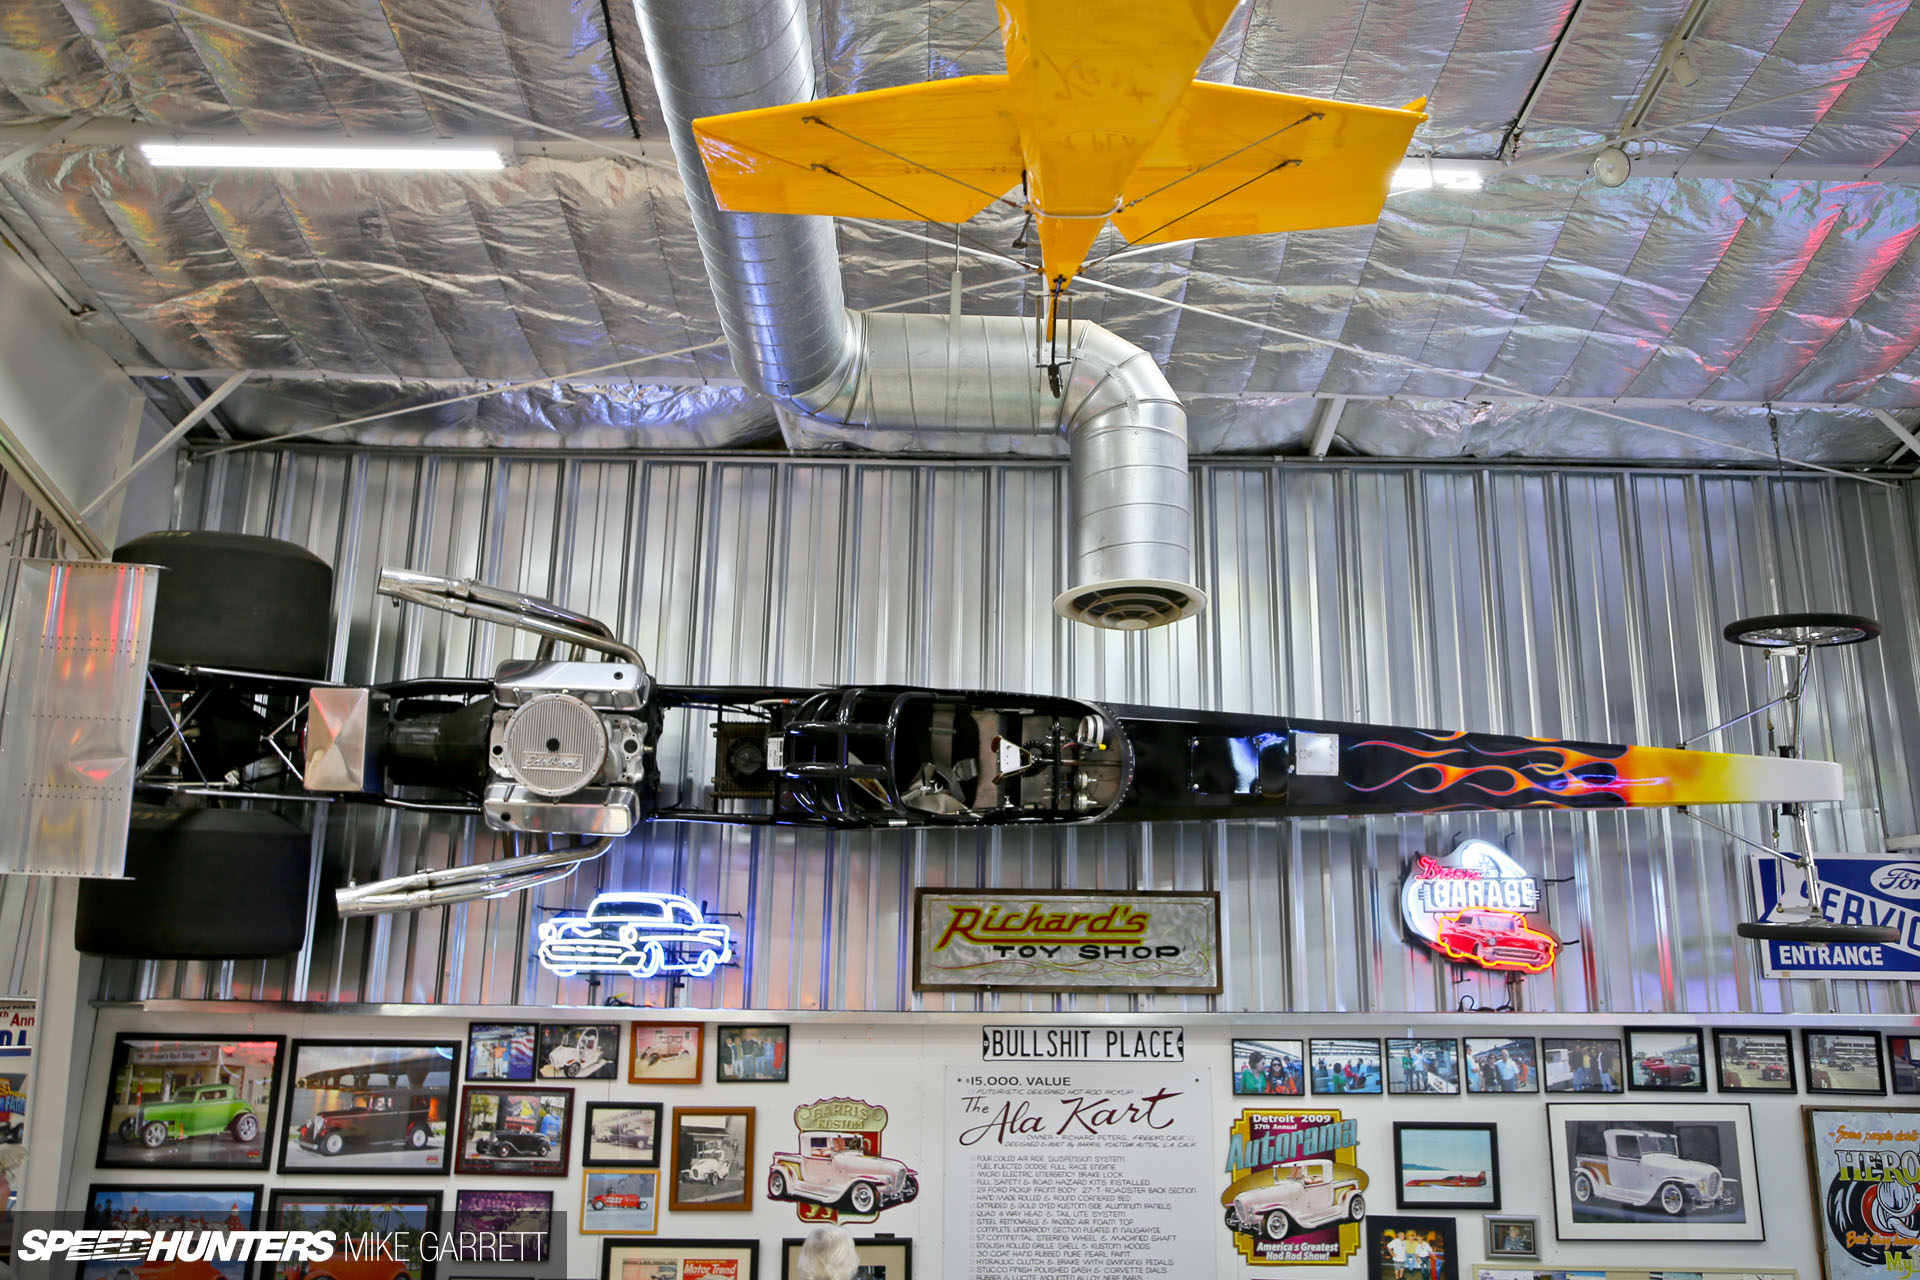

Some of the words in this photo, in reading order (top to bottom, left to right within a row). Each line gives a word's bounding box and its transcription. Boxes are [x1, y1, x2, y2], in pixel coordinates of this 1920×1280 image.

[1415, 856, 1483, 880] Dream
[1430, 879, 1534, 907] GARAGE
[933, 904, 1151, 951] Richard's
[1779, 945, 1884, 966] ENTRANCE
[992, 1030, 1090, 1058] BULLSHIT
[1106, 1030, 1174, 1058] PLACE
[1026, 1077, 1071, 1086] VALUE
[813, 1104, 869, 1120] BARRIS
[961, 1095, 989, 1113] The
[1056, 1087, 1184, 1135] Kart
[817, 1119, 864, 1129] KUSTOM
[959, 1100, 1046, 1146] Ala
[1253, 1114, 1295, 1123] Detroit
[1300, 1114, 1331, 1123] 2009
[1225, 1119, 1358, 1173] Autorama
[1256, 1242, 1300, 1251] America's
[1301, 1242, 1339, 1251] Greatest
[1285, 1252, 1302, 1260] Rod
[1303, 1252, 1330, 1260] Show!
[684, 1263, 711, 1275] Motor
[711, 1263, 737, 1275] Trend
